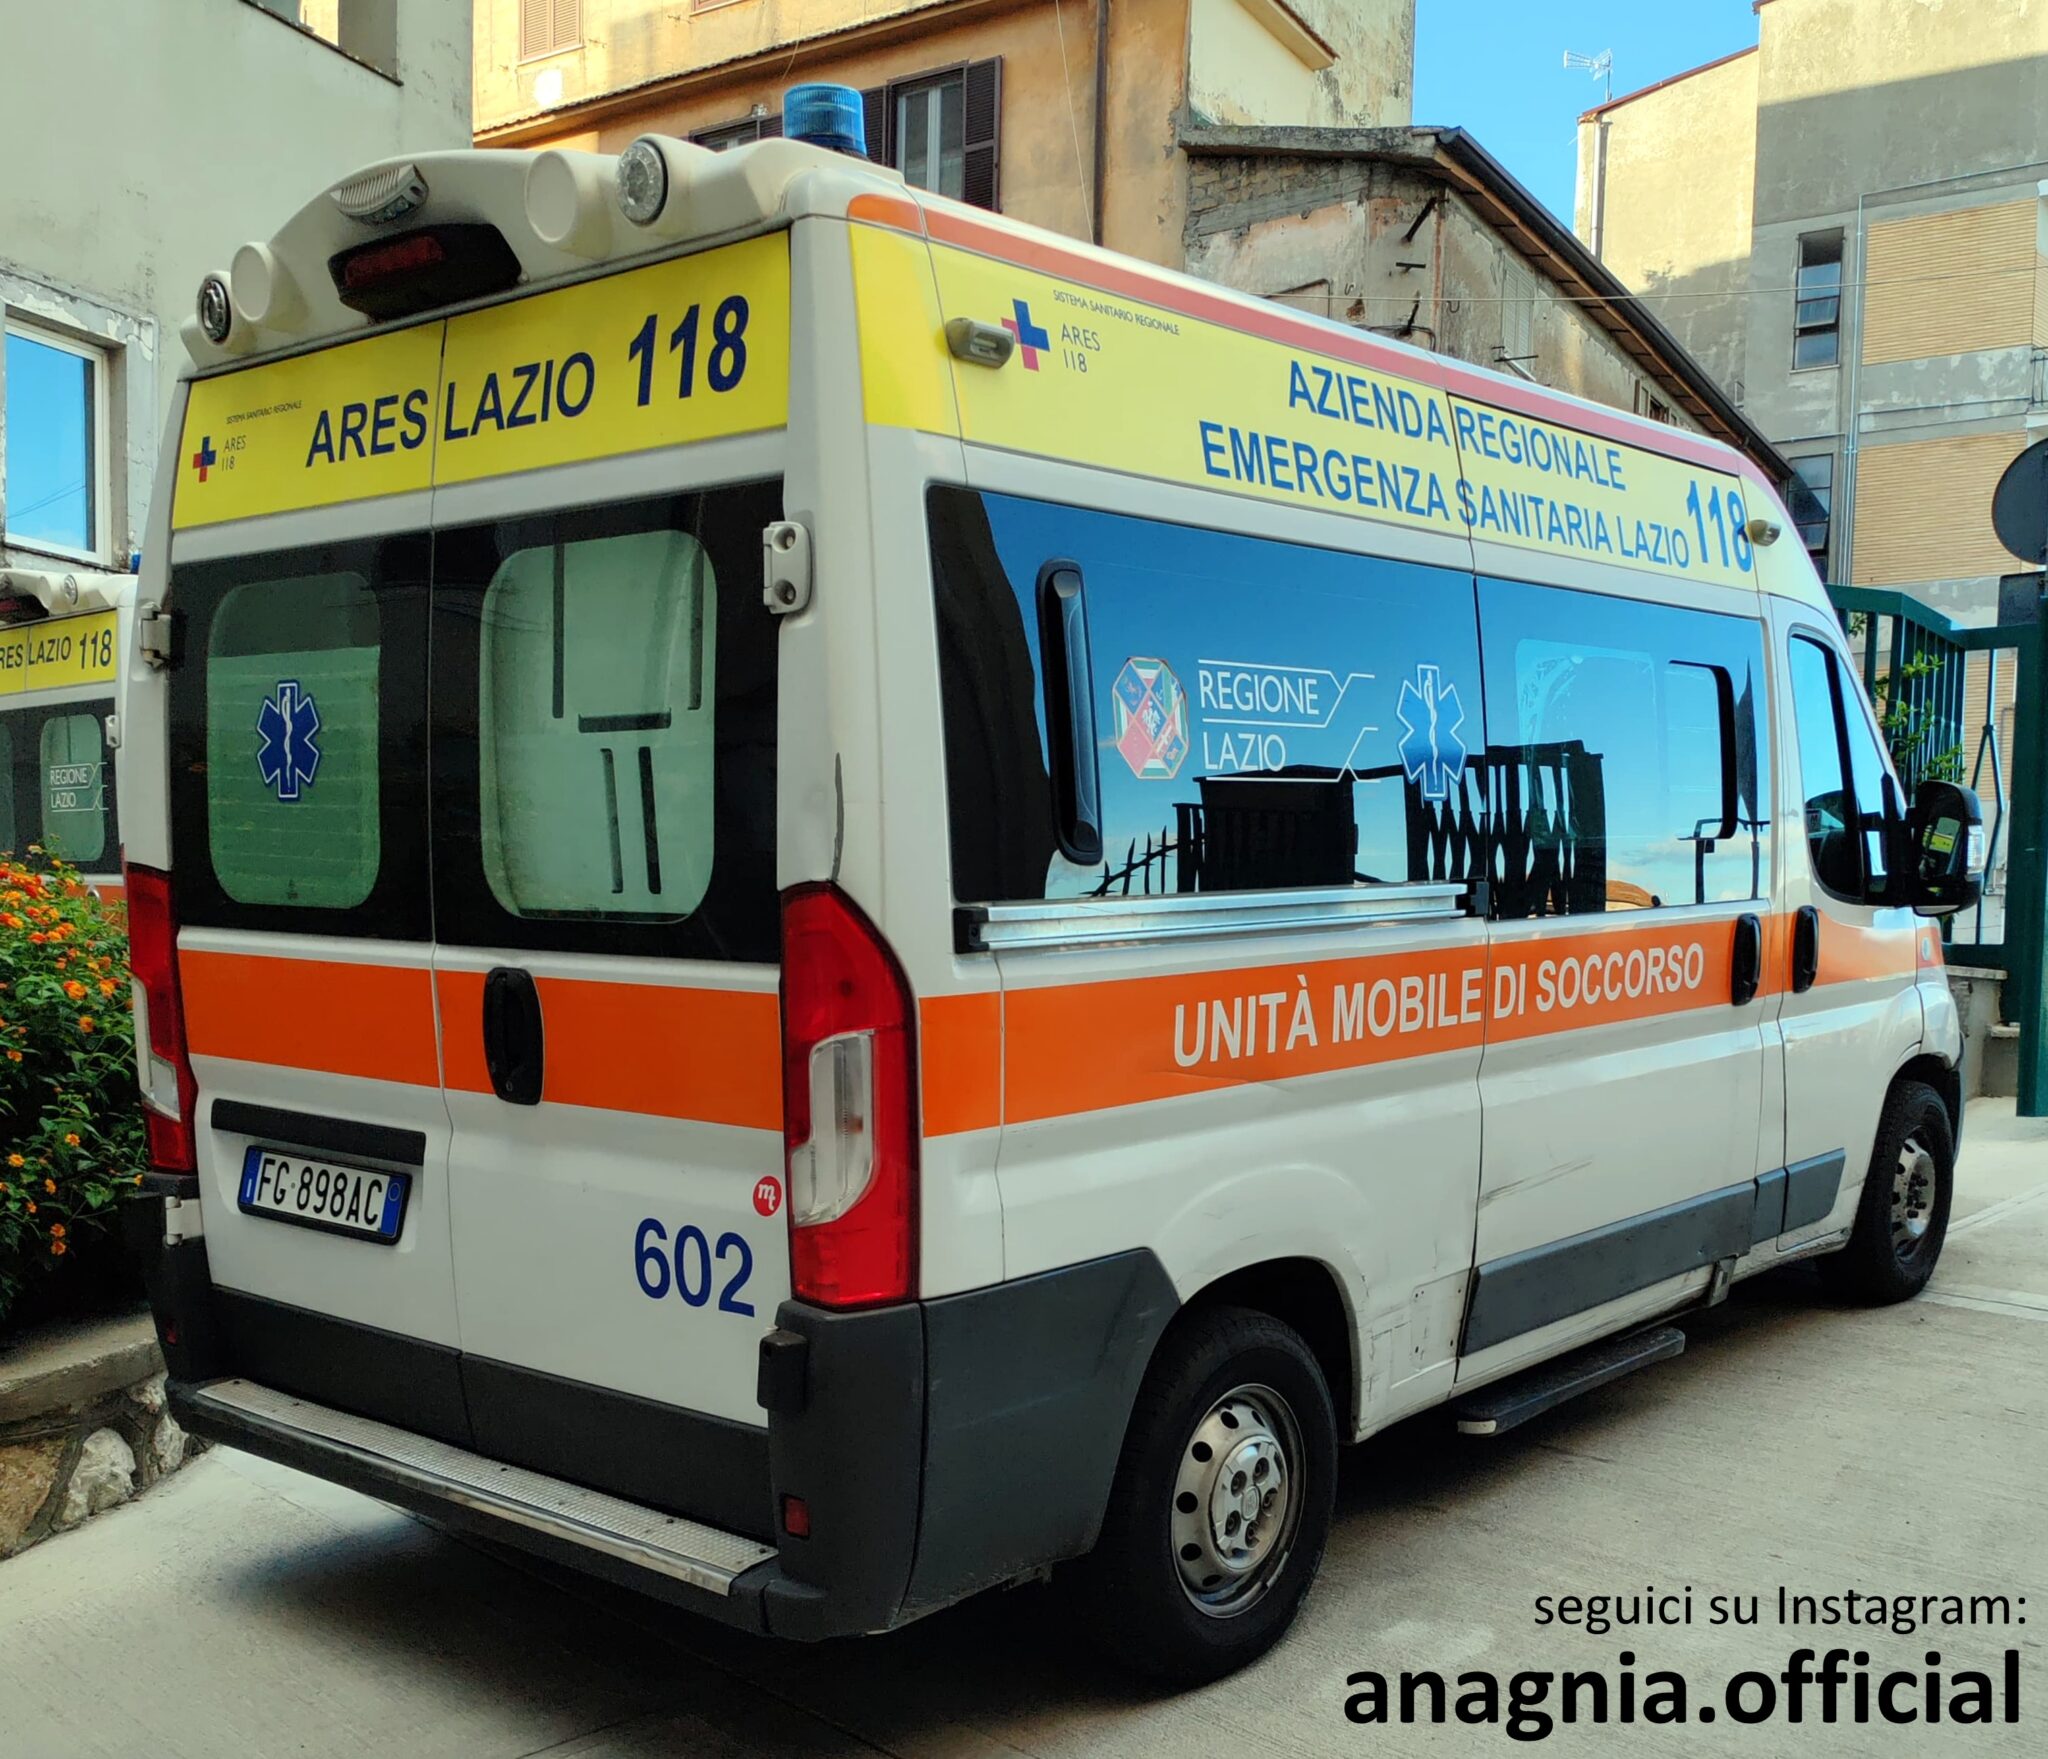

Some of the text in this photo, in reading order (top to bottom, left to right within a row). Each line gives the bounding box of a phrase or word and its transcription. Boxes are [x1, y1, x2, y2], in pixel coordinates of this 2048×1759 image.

[1053, 289, 1180, 336] SISTEMA SANITARIO REGIONALE
[1061, 323, 1101, 352] ARES
[305, 294, 750, 468] ARES LAZIO 118
[1063, 348, 1088, 373] 118
[223, 435, 246, 453] ARES
[1288, 360, 1626, 491] AZIENDA REGIONALE
[221, 456, 235, 472] 118
[1199, 420, 1690, 569] EMERGENZA SANITARIA LAZIO
[1686, 480, 1753, 573] 118
[28, 636, 71, 665] LAZIO
[79, 629, 112, 670] 118
[1199, 669, 1320, 716] REGIONE
[1203, 731, 1286, 772] LAZIO
[50, 766, 88, 785] REGIONE
[51, 792, 77, 809] LAZIO
[1174, 942, 1704, 1067] UNITÀ MOBILE DI SOCCORSO
[634, 1217, 756, 1318] 602
